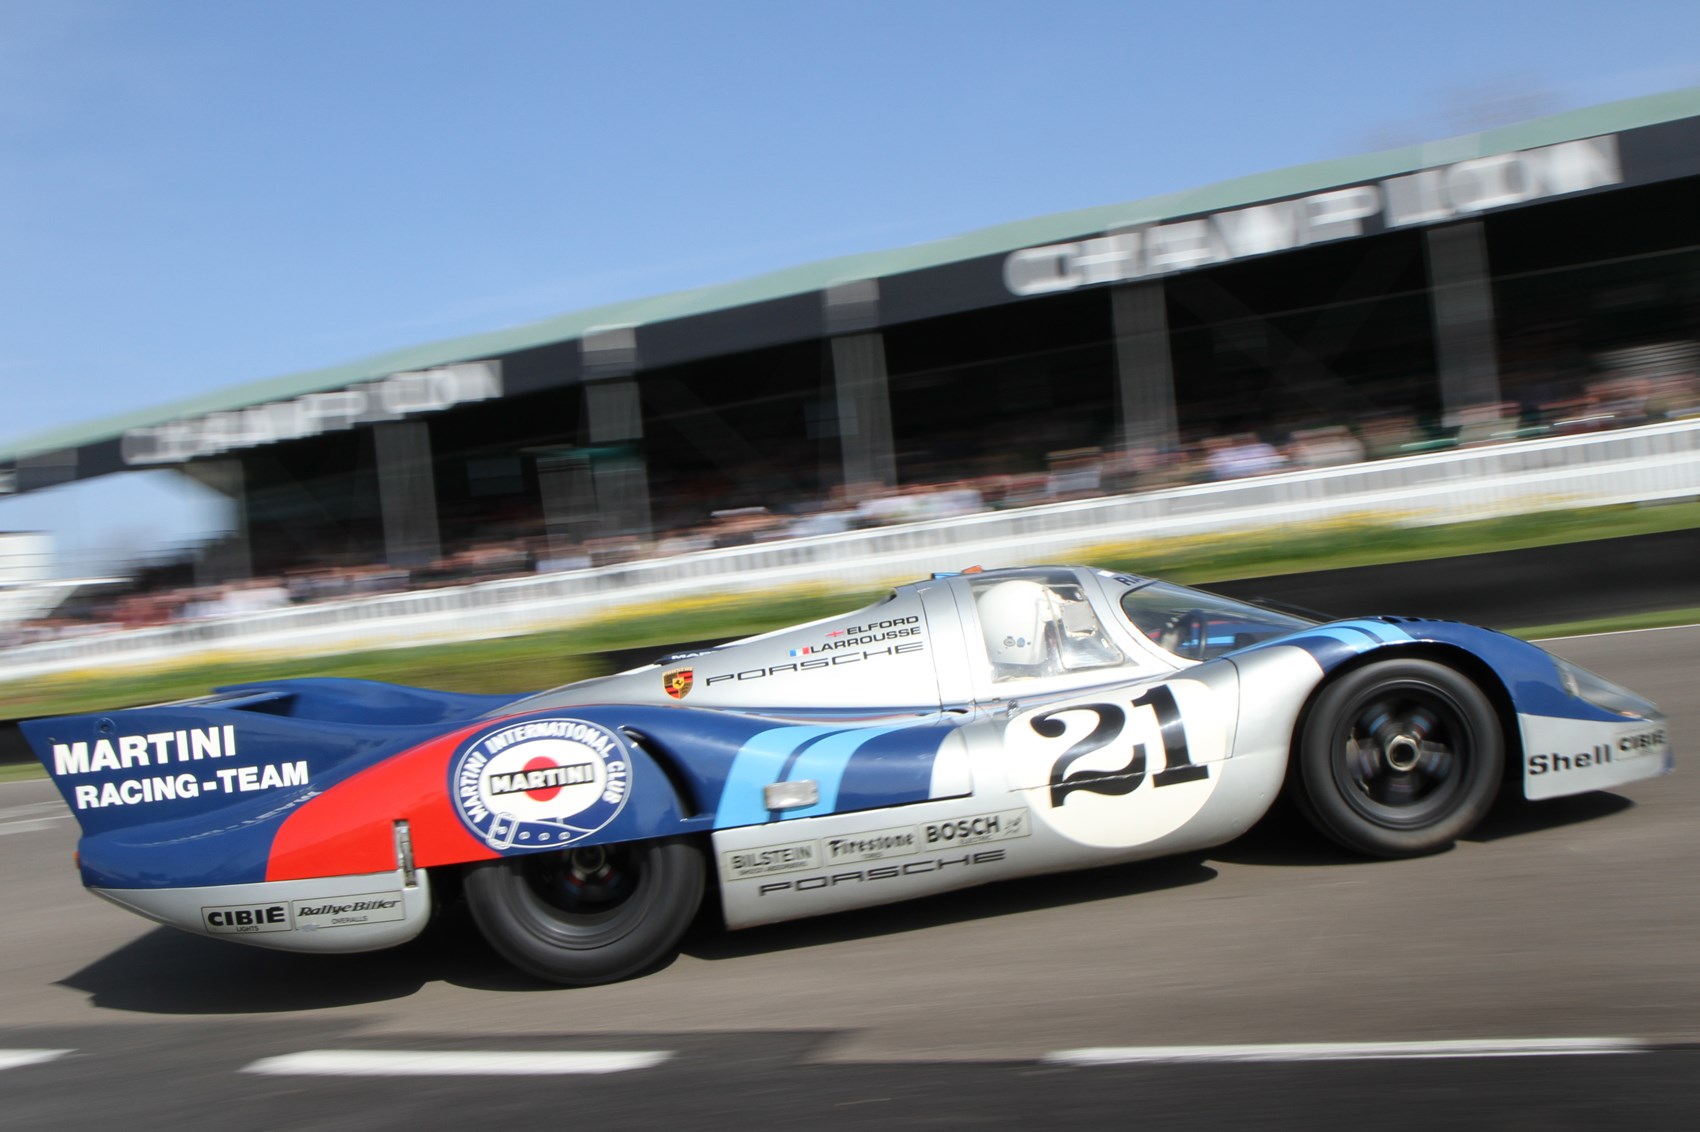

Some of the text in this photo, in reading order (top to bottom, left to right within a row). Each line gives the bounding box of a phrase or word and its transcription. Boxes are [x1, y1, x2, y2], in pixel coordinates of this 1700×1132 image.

[810, 626, 921, 654] LARROUSSE
[846, 615, 919, 636] ELFORD
[705, 640, 924, 687] PORSCHE
[53, 725, 236, 775] MARTINI
[1029, 684, 1210, 809] 21
[1528, 743, 1613, 776] Shell
[75, 760, 309, 810] RACING-TEAM
[460, 722, 627, 824] MARTINI INTERNATIONAL CLUB
[490, 764, 594, 794] MARTINI
[828, 832, 914, 859] Firestone
[926, 815, 1000, 843] BOSCH
[732, 845, 812, 870] BILSTEIN
[759, 849, 1006, 896] PORSCHE
